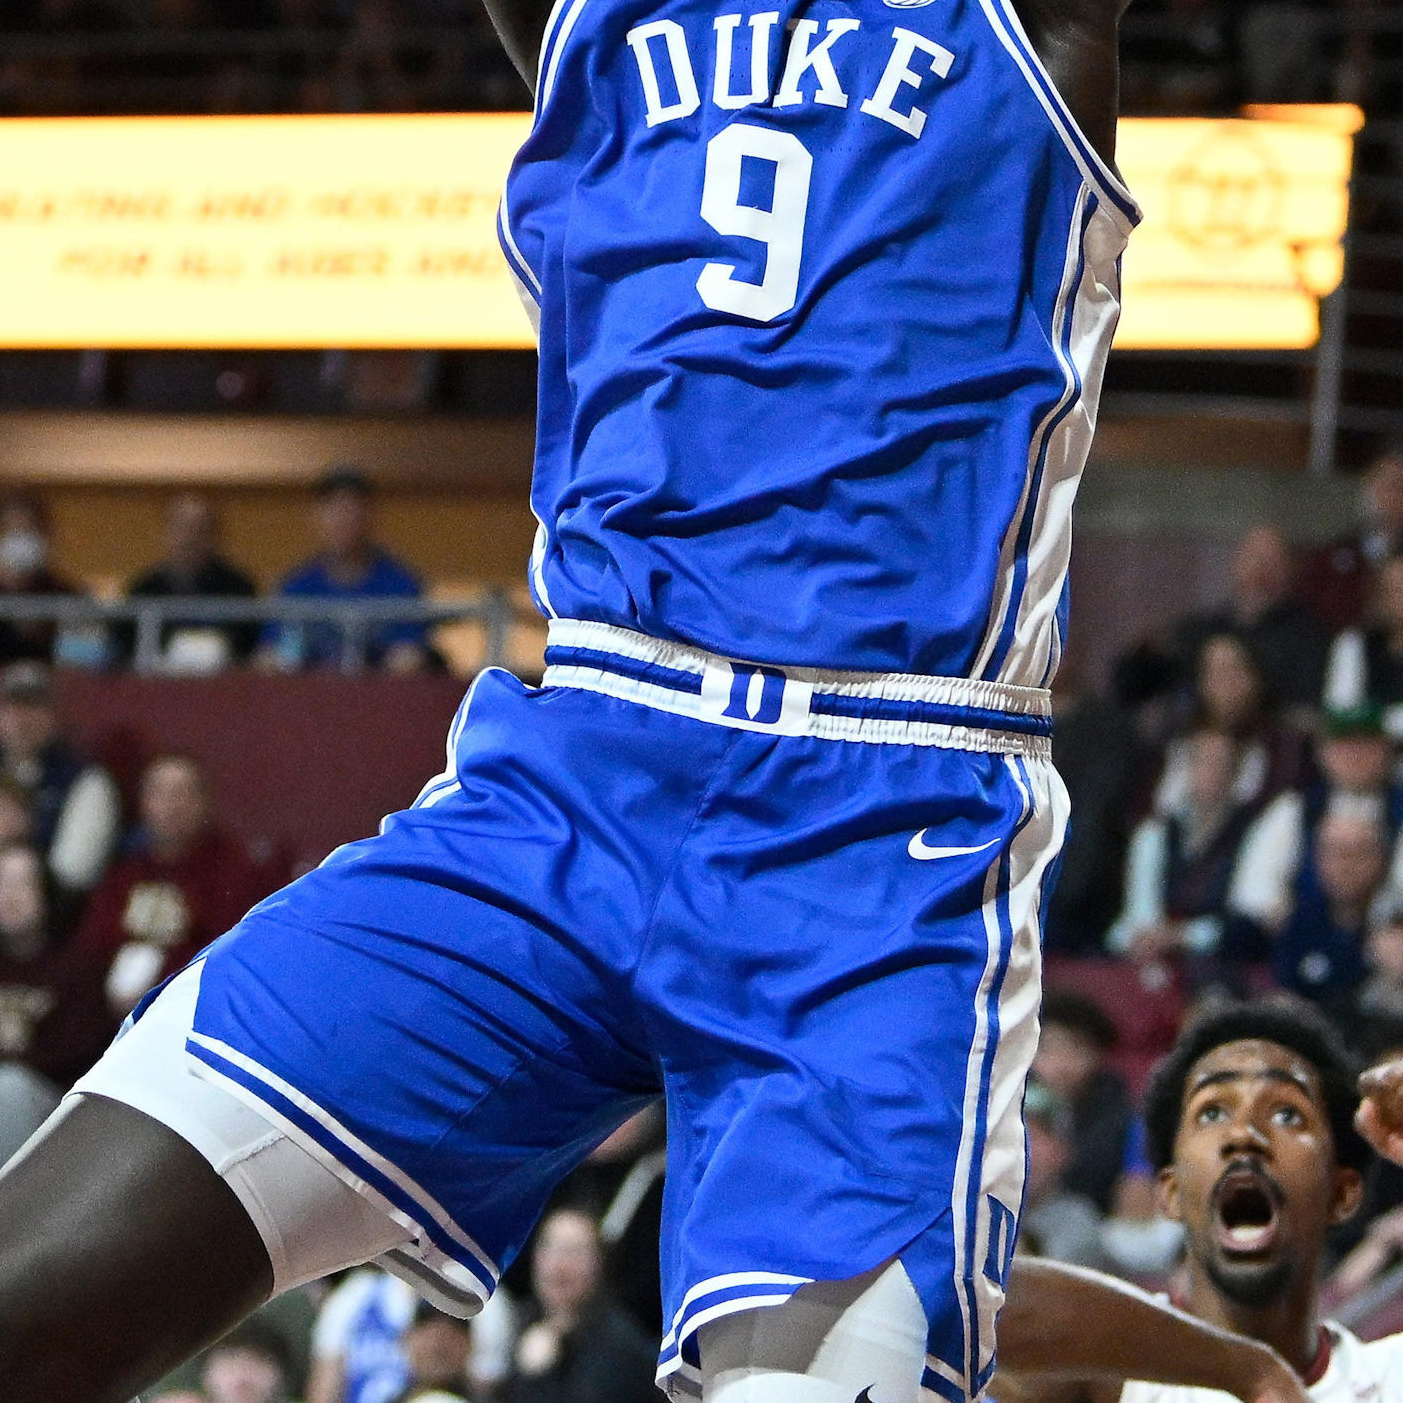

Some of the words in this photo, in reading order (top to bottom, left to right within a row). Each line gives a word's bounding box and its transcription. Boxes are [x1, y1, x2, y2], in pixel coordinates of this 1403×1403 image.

[626, 10, 956, 140] DUKE
[695, 122, 814, 323] 9
[721, 662, 787, 725] D
